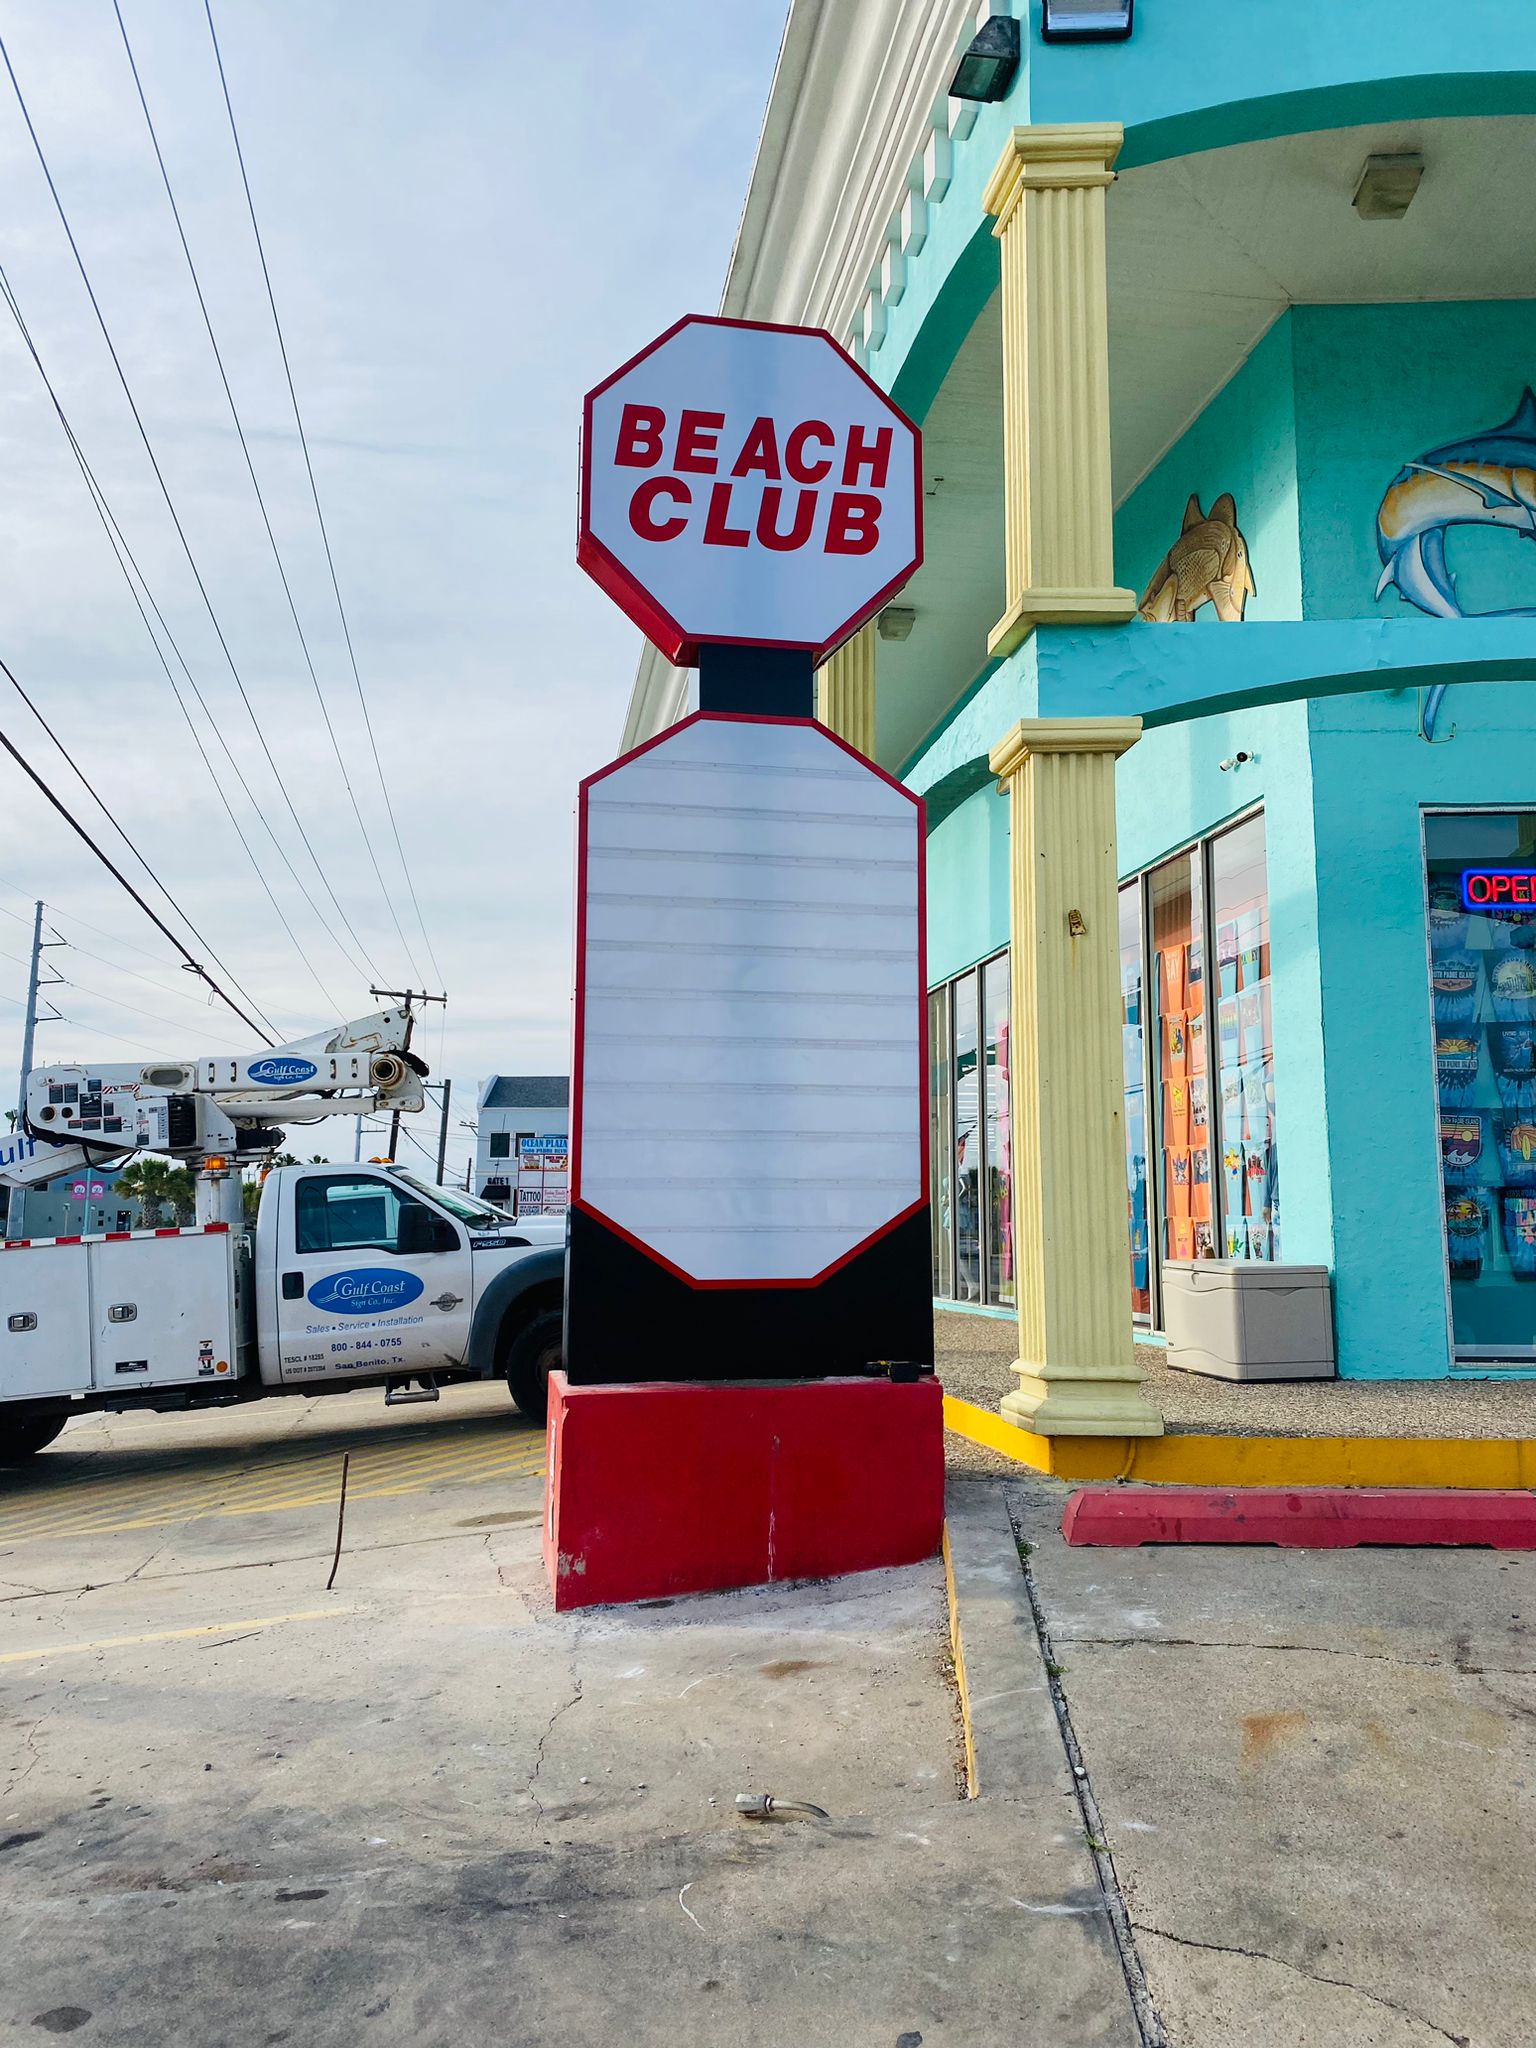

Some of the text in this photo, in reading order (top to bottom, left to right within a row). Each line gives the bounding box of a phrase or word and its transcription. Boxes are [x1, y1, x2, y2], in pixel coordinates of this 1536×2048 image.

[614, 403, 893, 488] BEACH
[628, 476, 882, 555] CLUB
[1468, 875, 1536, 902] OPE
[266, 1065, 315, 1075] Gulf Coast
[0, 1134, 36, 1166] ulf
[521, 1138, 567, 1147] OCEAN PLAZA
[519, 1189, 541, 1202] TATTOO
[340, 1280, 406, 1297] Gulf Coast
[351, 1299, 366, 1308] Sign
[305, 1315, 424, 1335] Sales Service Installation
[331, 1343, 348, 1352] 800
[355, 1340, 372, 1350] 844
[380, 1337, 402, 1348] 0755
[335, 1361, 354, 1370] San
[355, 1358, 389, 1368] Benito,
